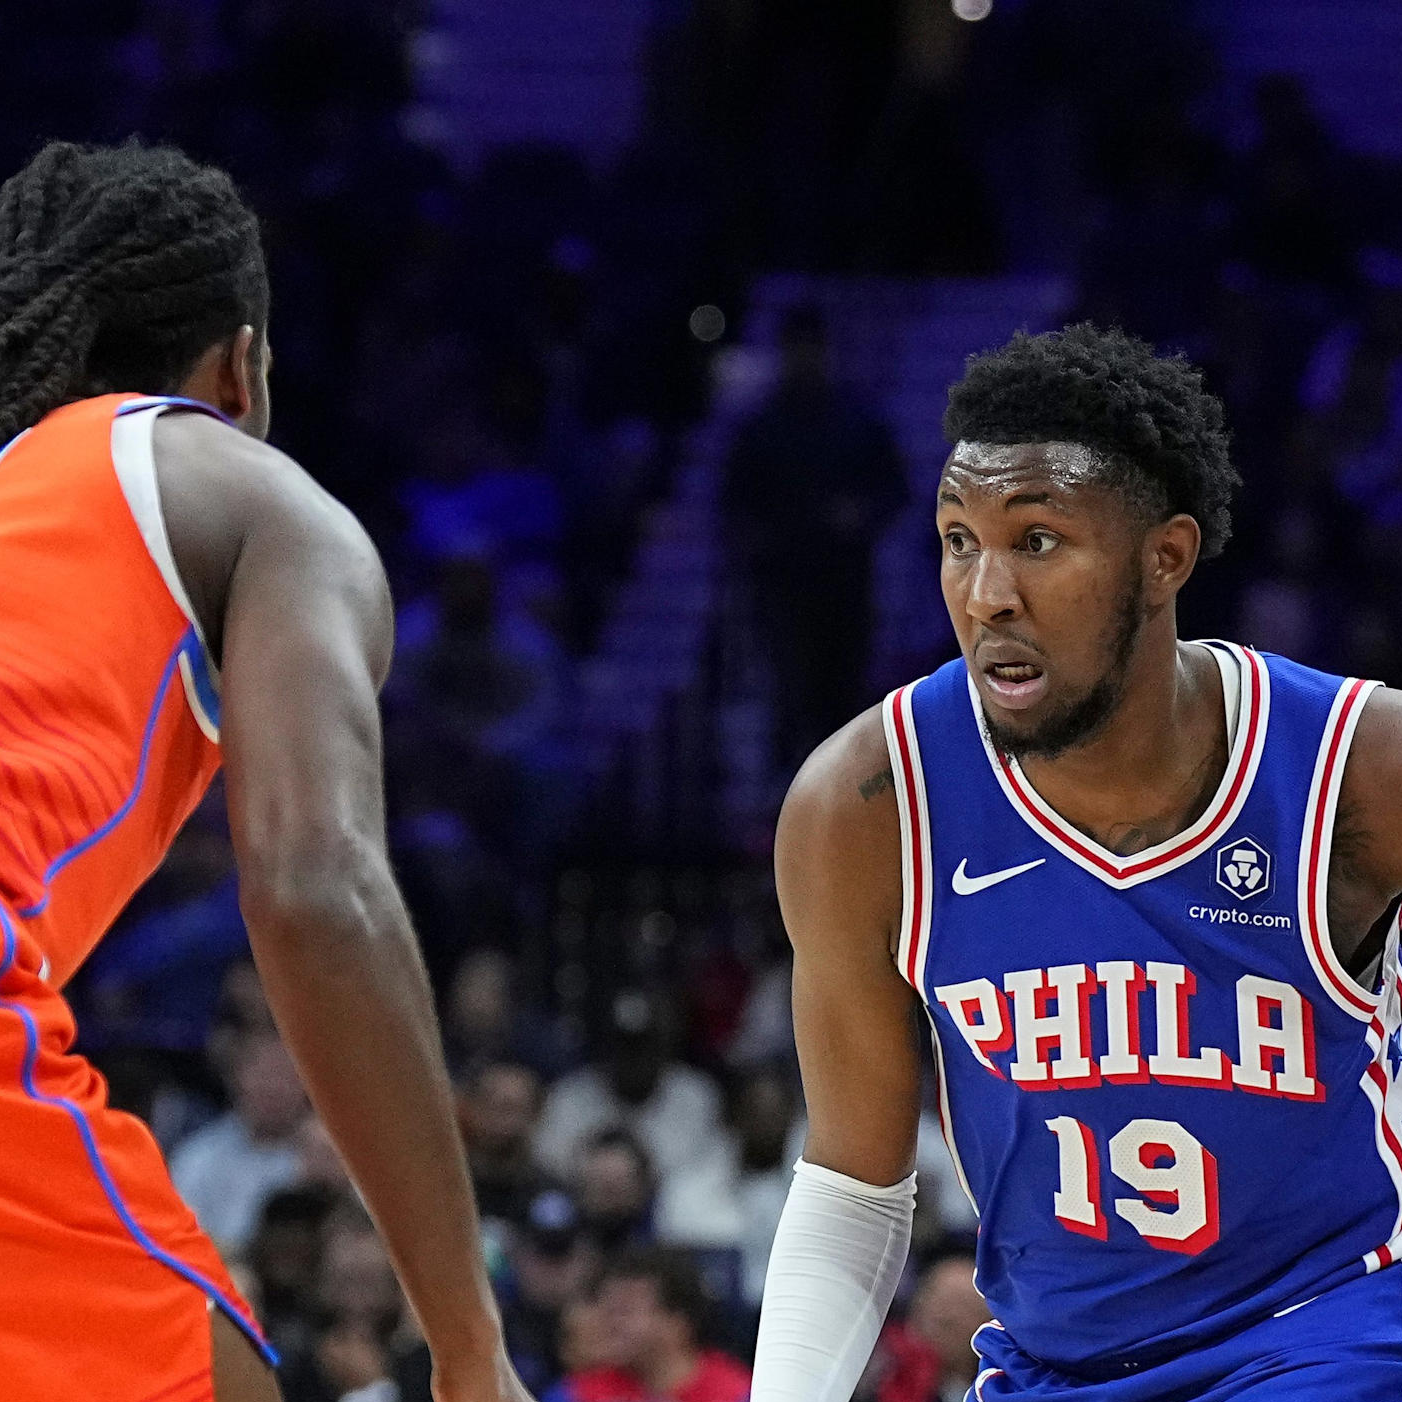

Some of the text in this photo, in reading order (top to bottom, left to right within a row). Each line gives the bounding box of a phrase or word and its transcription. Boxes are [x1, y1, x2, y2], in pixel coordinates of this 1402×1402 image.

[1189, 905, 1291, 929] crypto.com
[934, 961, 1325, 1102] PHILA
[1045, 1116, 1220, 1255] 19
